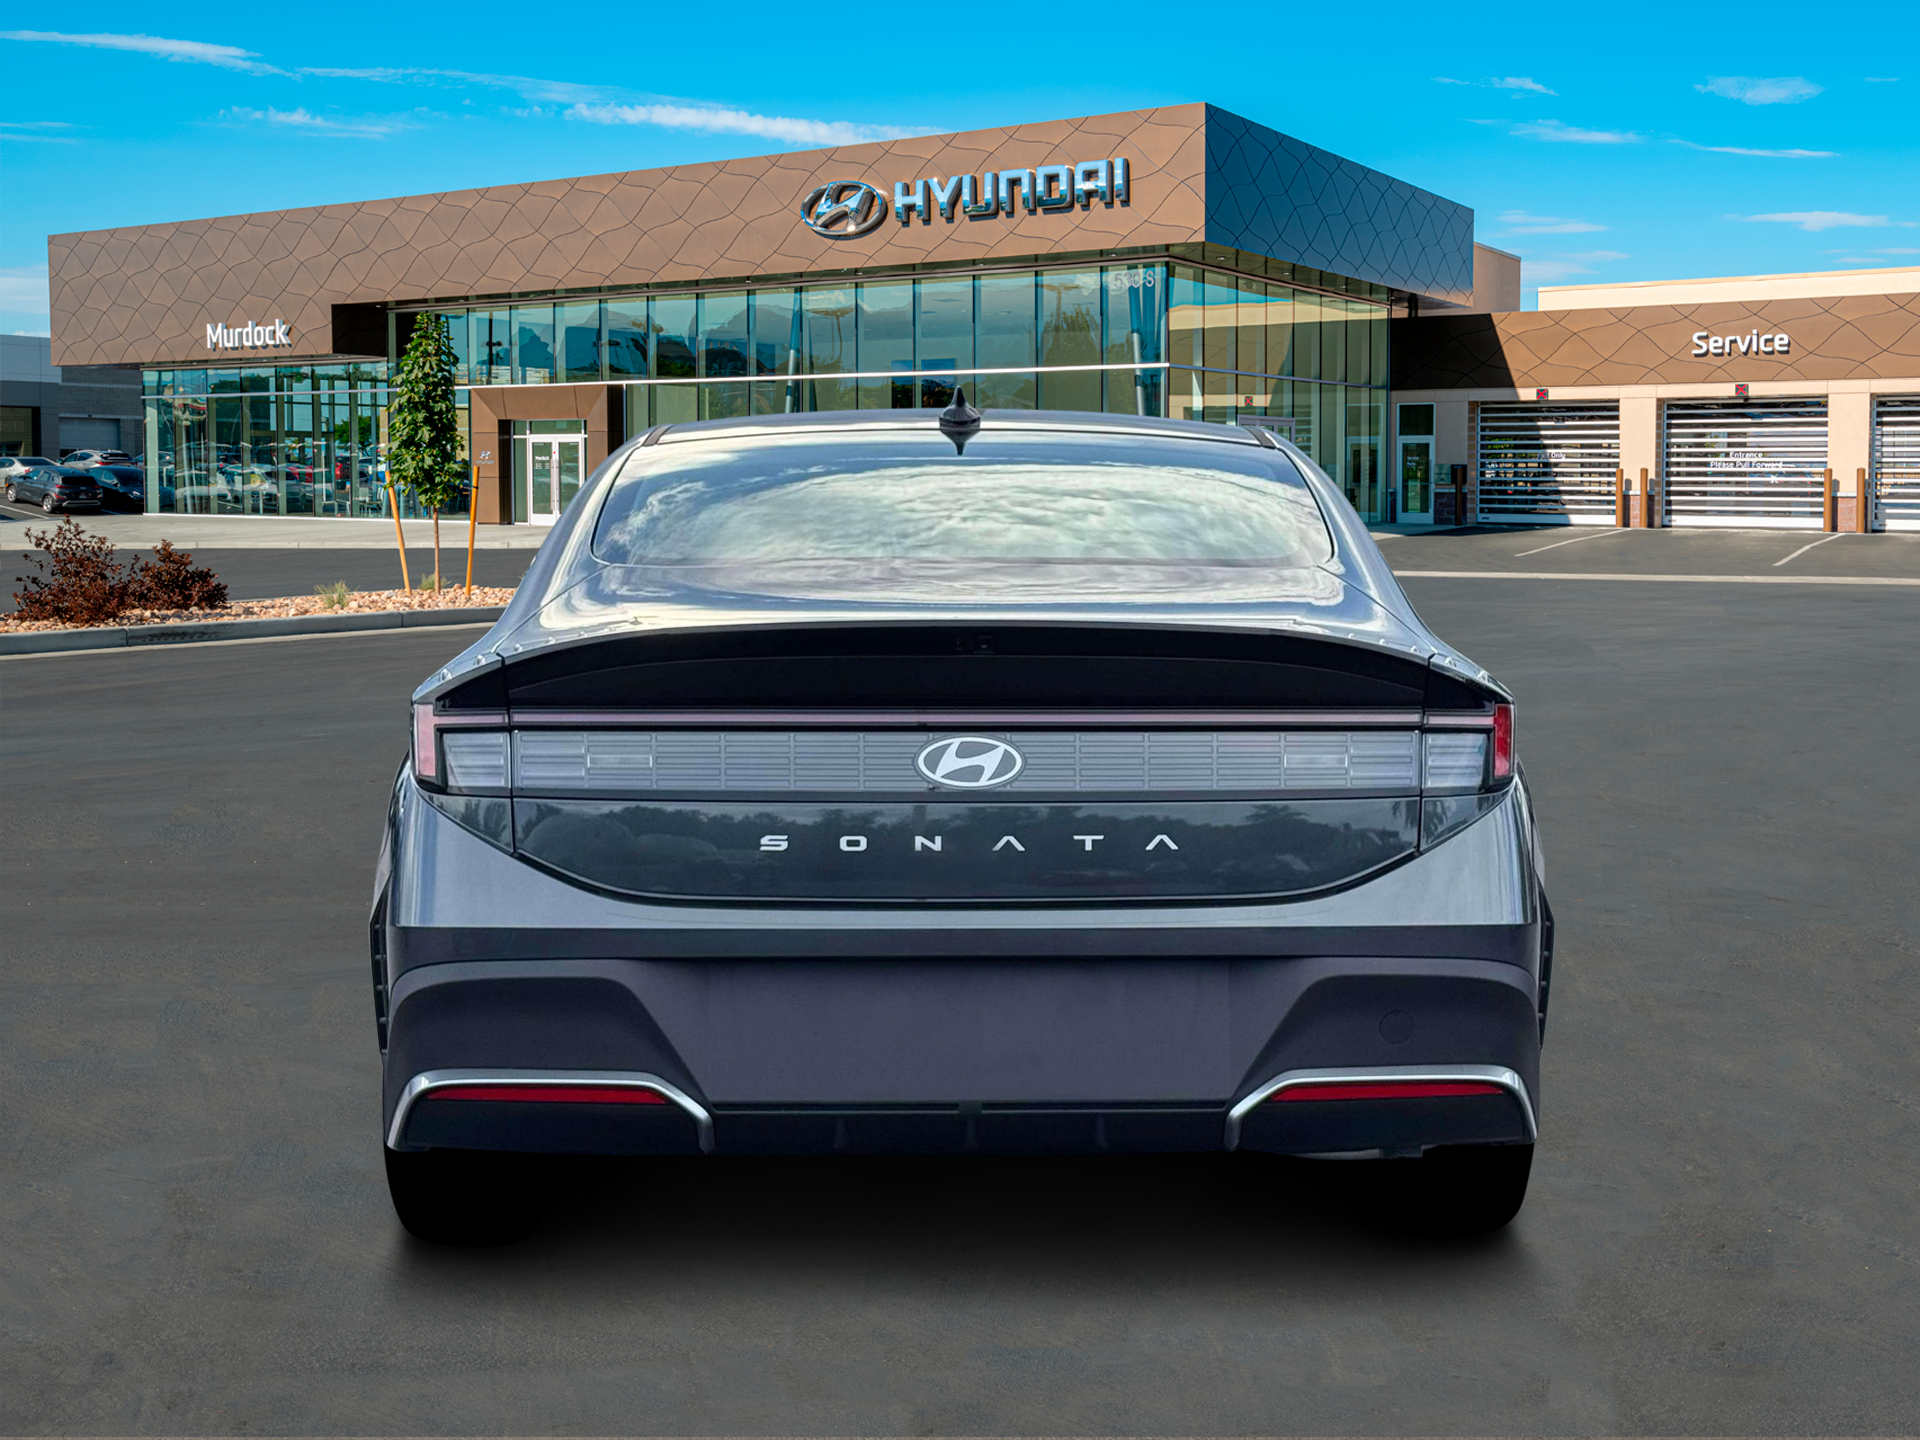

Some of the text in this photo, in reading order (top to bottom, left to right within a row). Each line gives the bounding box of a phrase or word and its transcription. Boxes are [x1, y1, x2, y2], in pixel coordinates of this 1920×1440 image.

[894, 157, 1129, 223] HYUNDAI
[1114, 270, 1155, 289] 530 S
[206, 318, 291, 349] Murdock
[1691, 329, 1790, 355] Service
[1551, 452, 1566, 460] Only
[1729, 451, 1763, 459] Entrance
[1710, 461, 1783, 469] Please Pull Forward
[760, 834, 1179, 852] SONATA
